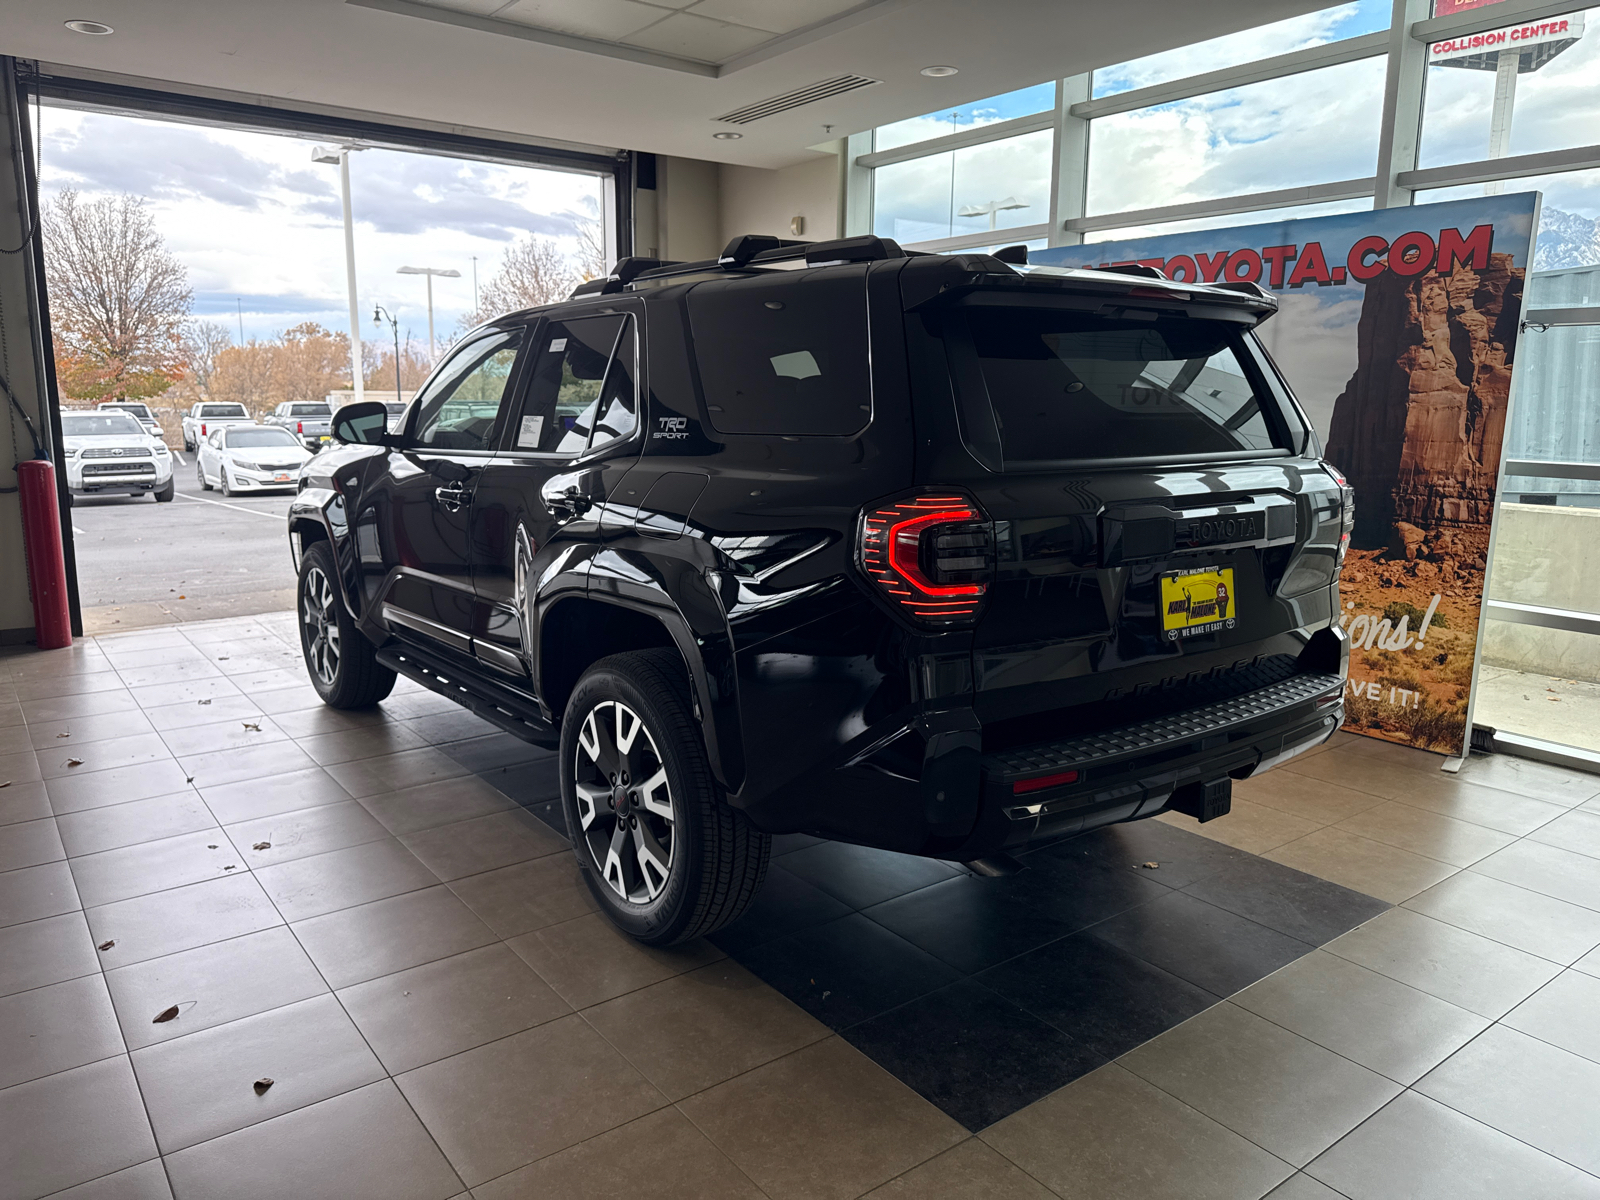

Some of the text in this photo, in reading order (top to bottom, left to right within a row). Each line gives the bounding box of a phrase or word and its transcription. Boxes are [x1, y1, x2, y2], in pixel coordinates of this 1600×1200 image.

[1433, 20, 1569, 54] COLLISION CENTER
[1080, 224, 1494, 290] OYOTA.COM
[659, 417, 688, 432] TRD
[1189, 517, 1257, 542] TOYOTA
[1178, 569, 1189, 577] KARL
[1218, 587, 1226, 597] 32
[1167, 599, 1187, 616] KARL
[1190, 602, 1217, 620] MALONE
[1182, 622, 1223, 637] WE MAKE IT EASY
[1339, 593, 1441, 652] ions!
[1345, 678, 1420, 710] VE IT!
